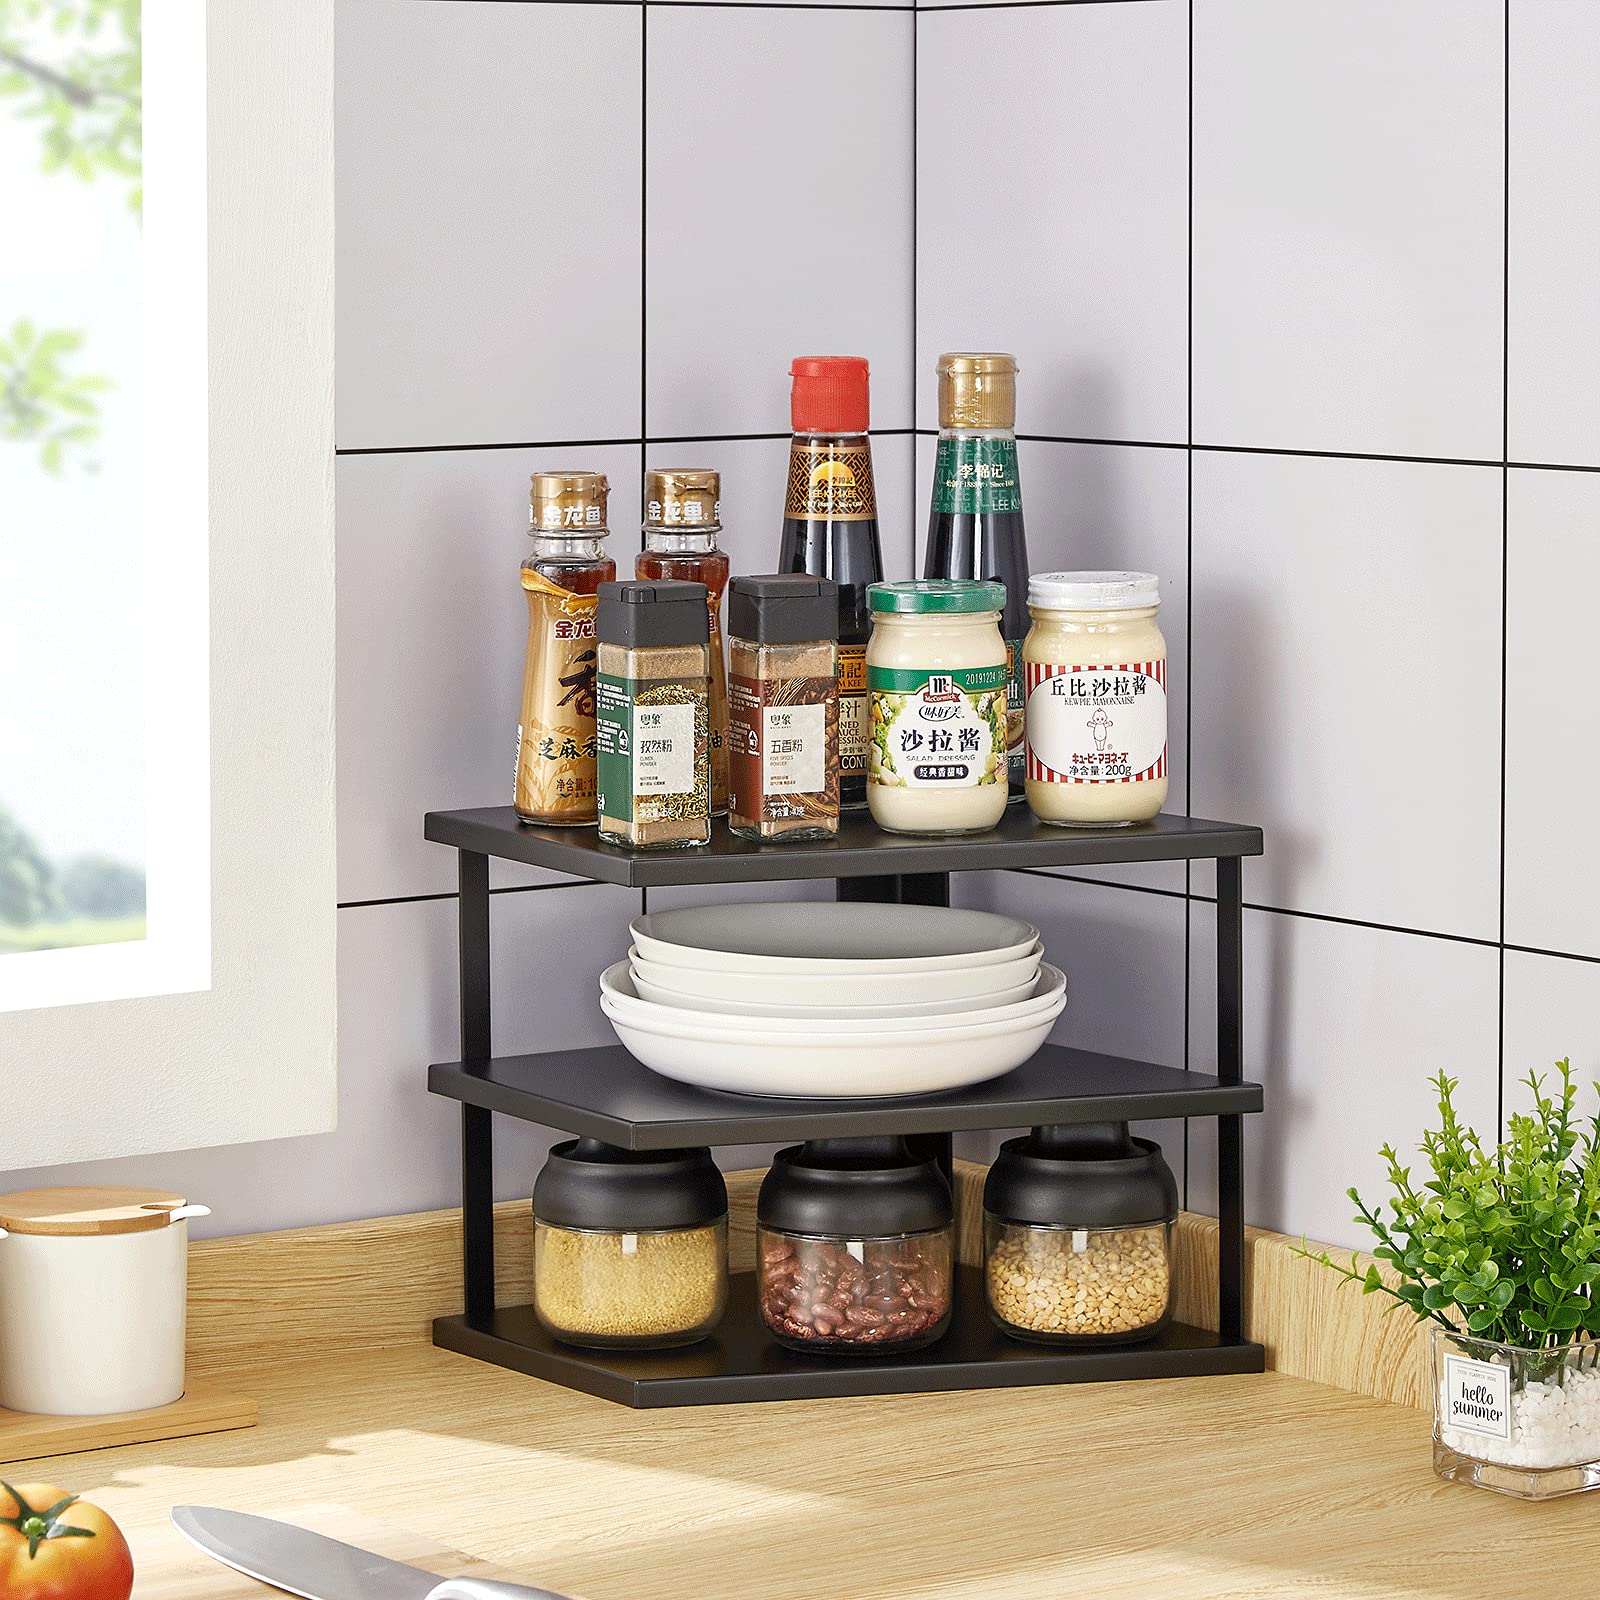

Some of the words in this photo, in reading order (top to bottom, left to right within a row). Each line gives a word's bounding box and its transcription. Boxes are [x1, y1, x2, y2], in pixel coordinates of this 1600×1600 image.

[960, 463, 1004, 479] 李锦记
[648, 500, 703, 522] 金龙鱼
[992, 500, 1009, 511] LEE
[543, 505, 600, 526] 金龙鱼
[555, 619, 598, 640] 金龙
[965, 671, 996, 685] 20191224
[924, 693, 958, 702] McCormick
[1064, 697, 1091, 706] KEWPIE
[1092, 696, 1135, 706] MAYONNAISE
[925, 705, 961, 719] 味好美
[640, 739, 673, 754] 孜然粉
[770, 739, 803, 754] 五香粉
[900, 727, 981, 752] 沙拉酱
[1072, 752, 1129, 765] キューピーマヨネーズ
[1461, 1381, 1494, 1406] hello
[1453, 1400, 1503, 1422] summer
